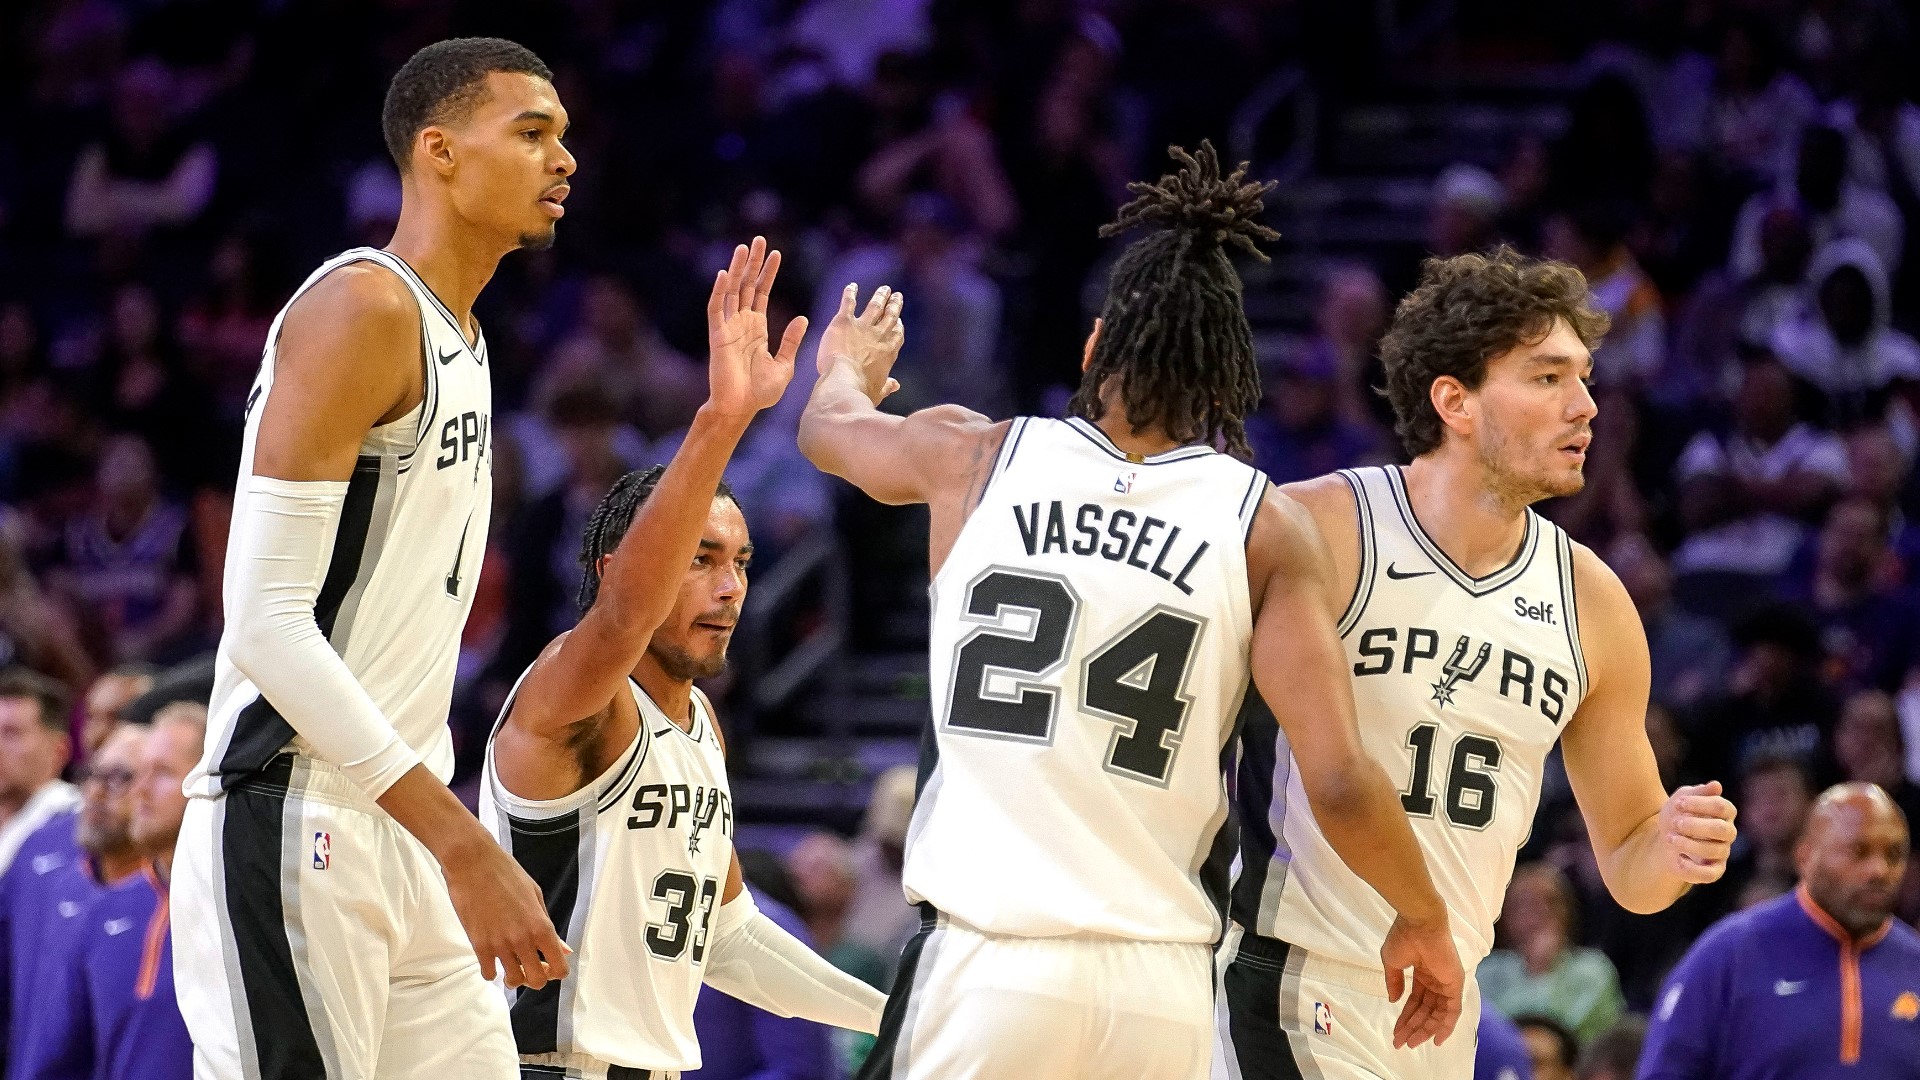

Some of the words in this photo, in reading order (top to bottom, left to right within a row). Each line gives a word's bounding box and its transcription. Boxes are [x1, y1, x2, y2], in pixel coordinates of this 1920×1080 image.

[437, 411, 491, 489] SPU
[444, 506, 474, 602] 1
[1013, 500, 1211, 597] VASSELL
[1514, 596, 1557, 625] Self.
[939, 563, 1210, 791] 24
[1353, 627, 1569, 726] SPURS
[627, 783, 734, 859] SPUR
[1397, 720, 1504, 832] 16
[643, 867, 719, 966] 33
